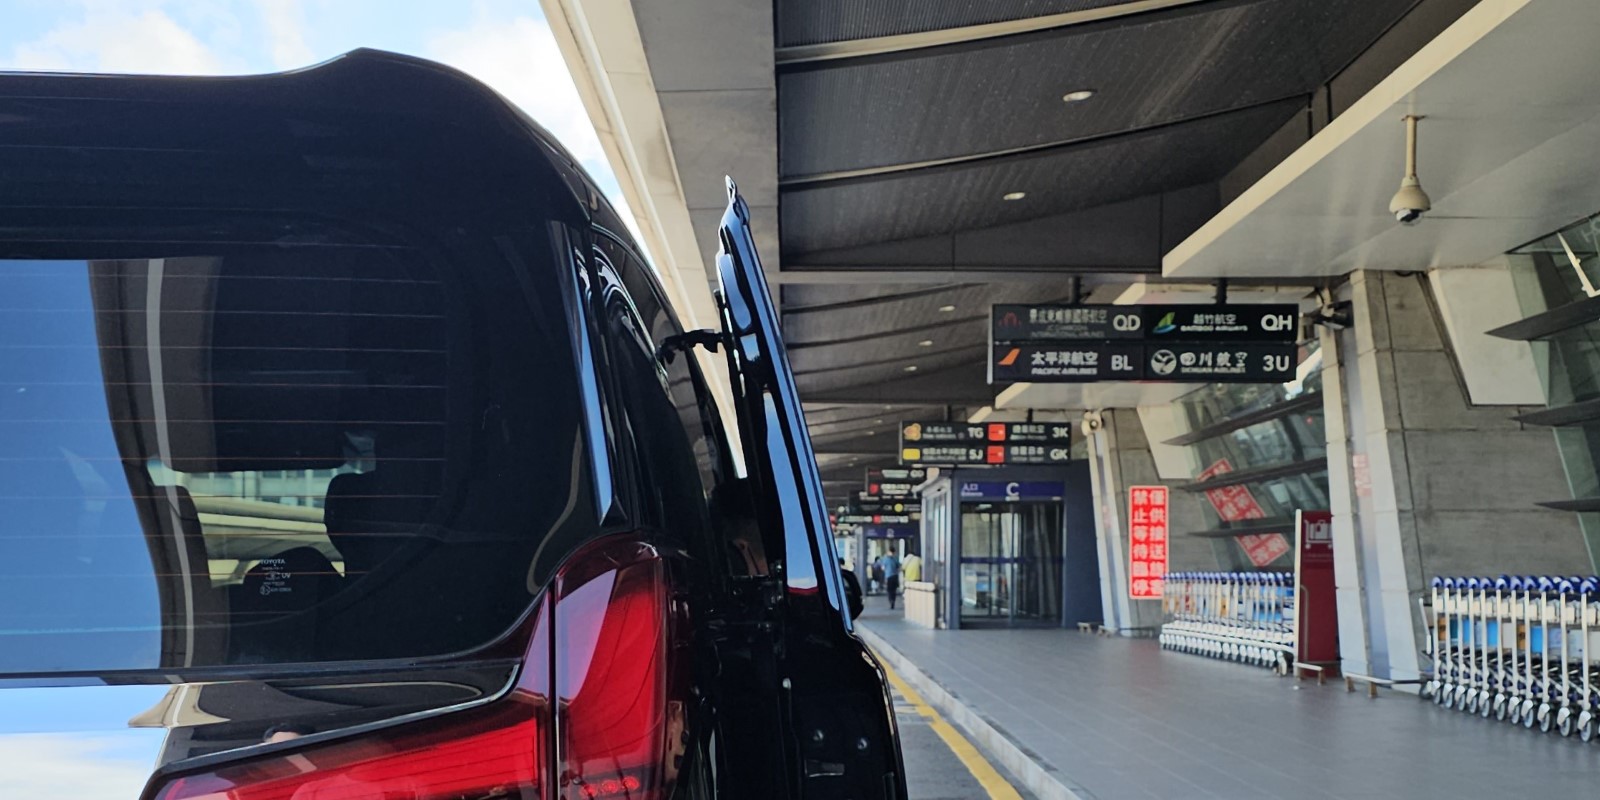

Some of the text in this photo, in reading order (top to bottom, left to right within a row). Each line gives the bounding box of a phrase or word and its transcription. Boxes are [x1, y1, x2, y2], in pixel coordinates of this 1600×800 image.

[1113, 315, 1141, 331] QD
[1261, 314, 1292, 331] QH
[1031, 351, 1098, 365] 太平洋航空
[1111, 354, 1133, 371] BL
[1262, 354, 1290, 372] 3U
[967, 427, 984, 439] TG
[1052, 426, 1069, 438] 3K
[1050, 448, 1068, 460] GK
[1006, 482, 1020, 496] C
